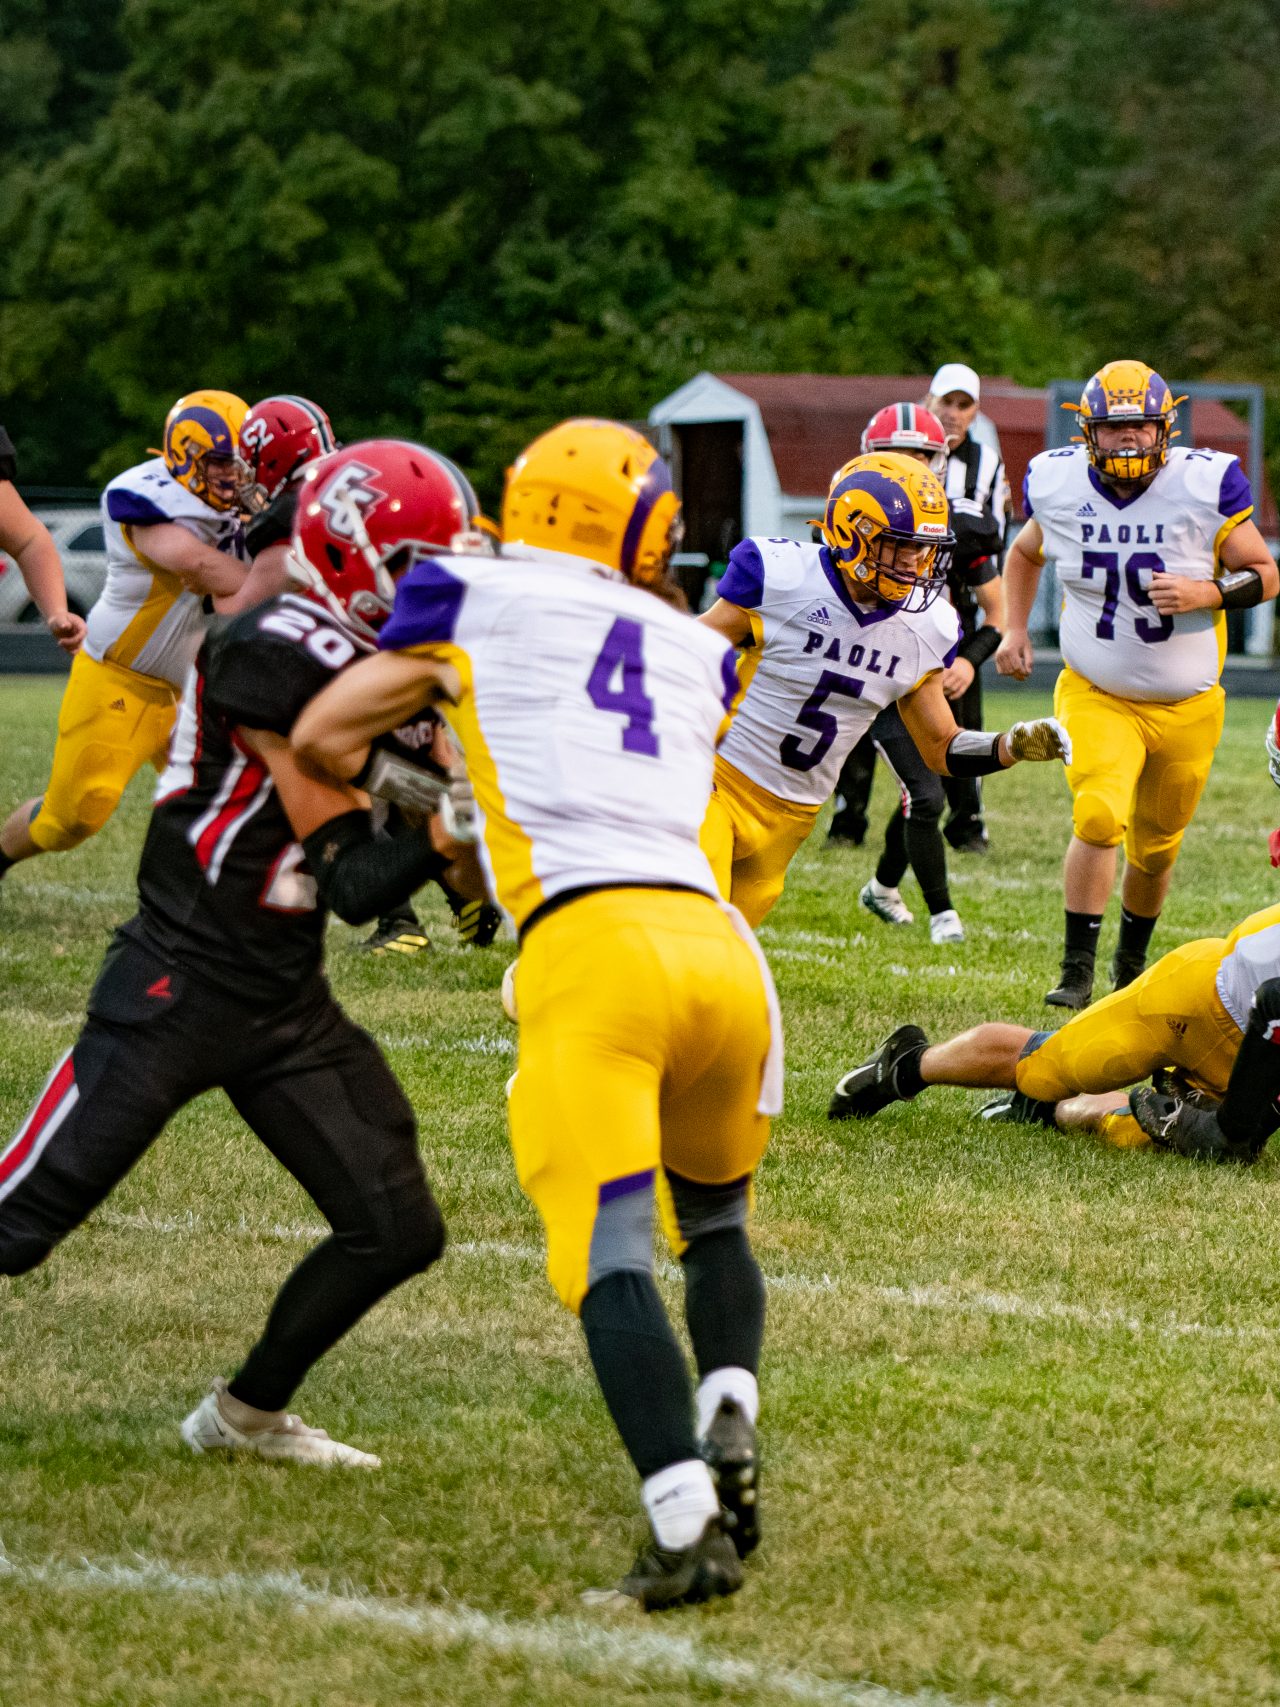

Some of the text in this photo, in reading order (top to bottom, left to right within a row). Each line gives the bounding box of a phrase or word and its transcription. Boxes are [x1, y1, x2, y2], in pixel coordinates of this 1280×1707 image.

[922, 525, 946, 534] Riddell
[1080, 523, 1164, 545] PAOLI
[806, 614, 833, 628] adidas
[1081, 551, 1175, 643] 79
[259, 608, 356, 669] 20
[802, 630, 902, 679] PAOLI
[586, 614, 660, 758] 4
[779, 669, 866, 772] 5
